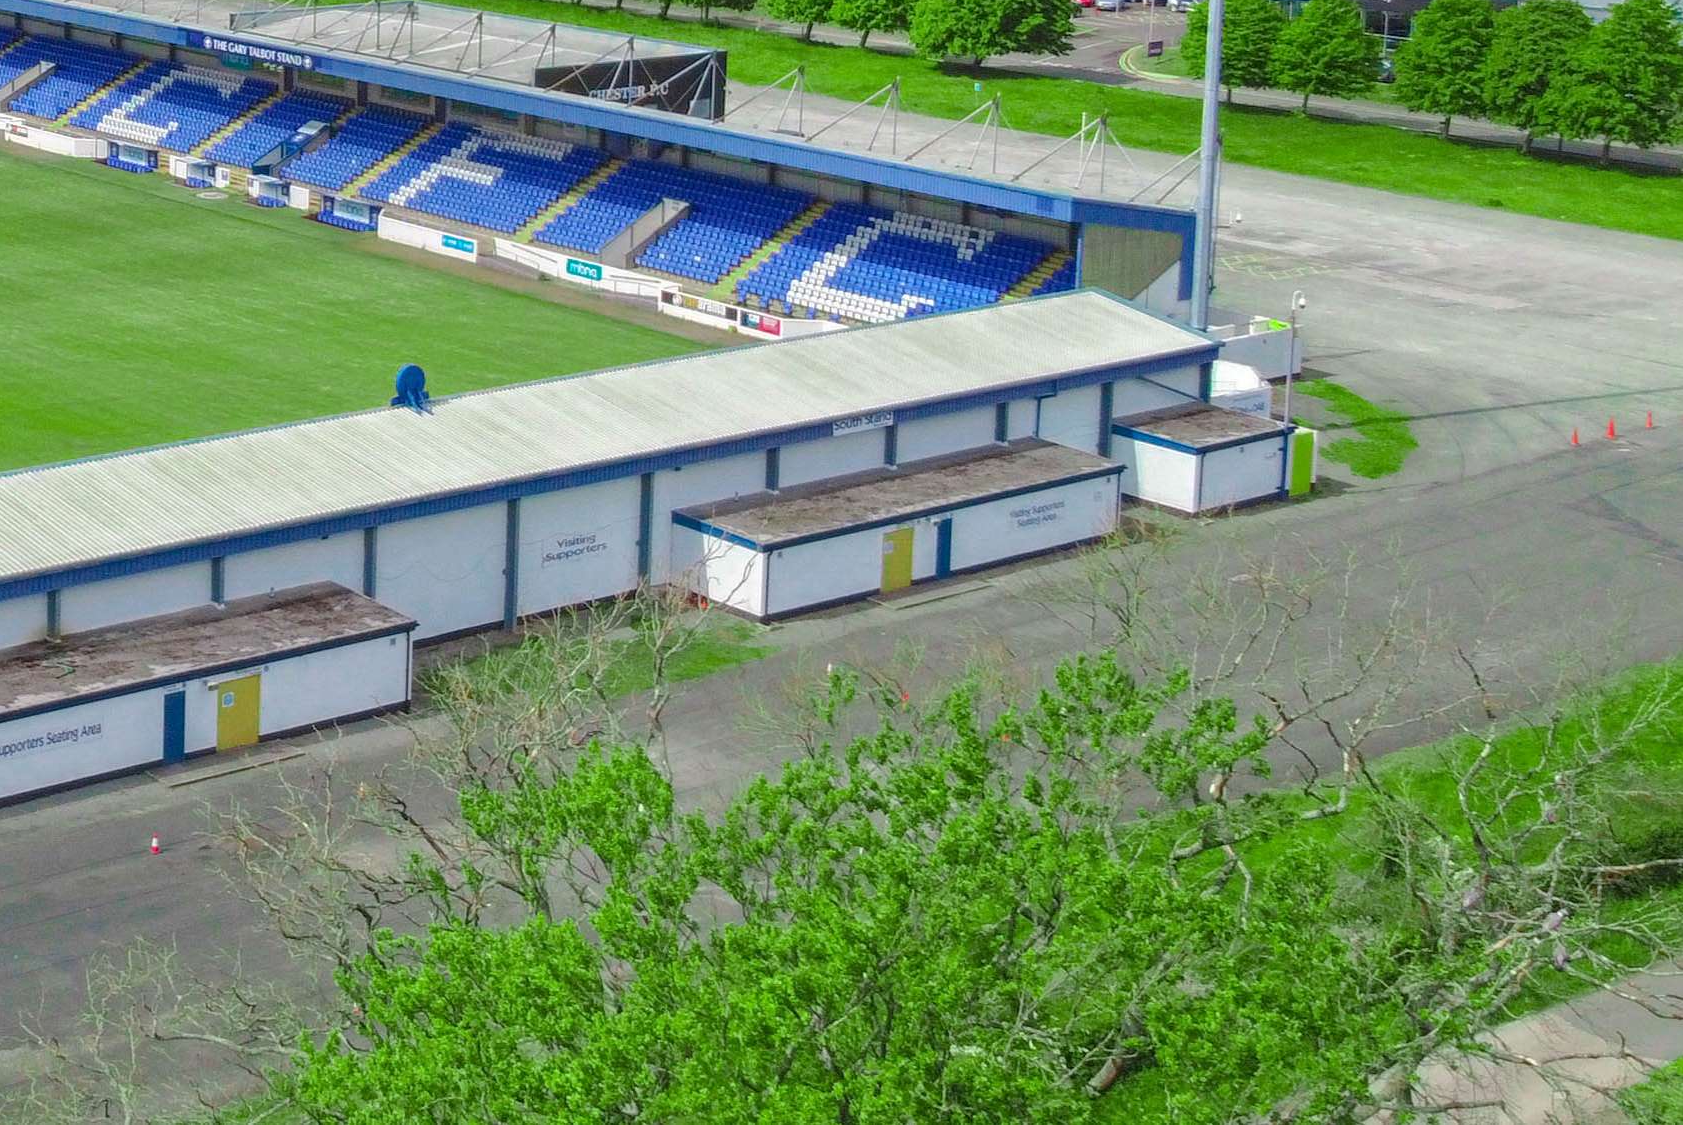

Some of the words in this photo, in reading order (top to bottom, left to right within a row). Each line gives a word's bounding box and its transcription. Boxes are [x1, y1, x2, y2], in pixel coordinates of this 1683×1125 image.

[213, 39, 227, 52] THE
[228, 42, 247, 55] GARY
[248, 46, 276, 60] TALBOT
[277, 52, 302, 66] STAND
[589, 85, 646, 101] CHESTER
[569, 261, 597, 278] mbna
[557, 534, 596, 548] Visiting
[541, 542, 607, 562] Supporters
[46, 728, 79, 745] Seating
[80, 723, 102, 737] Area
